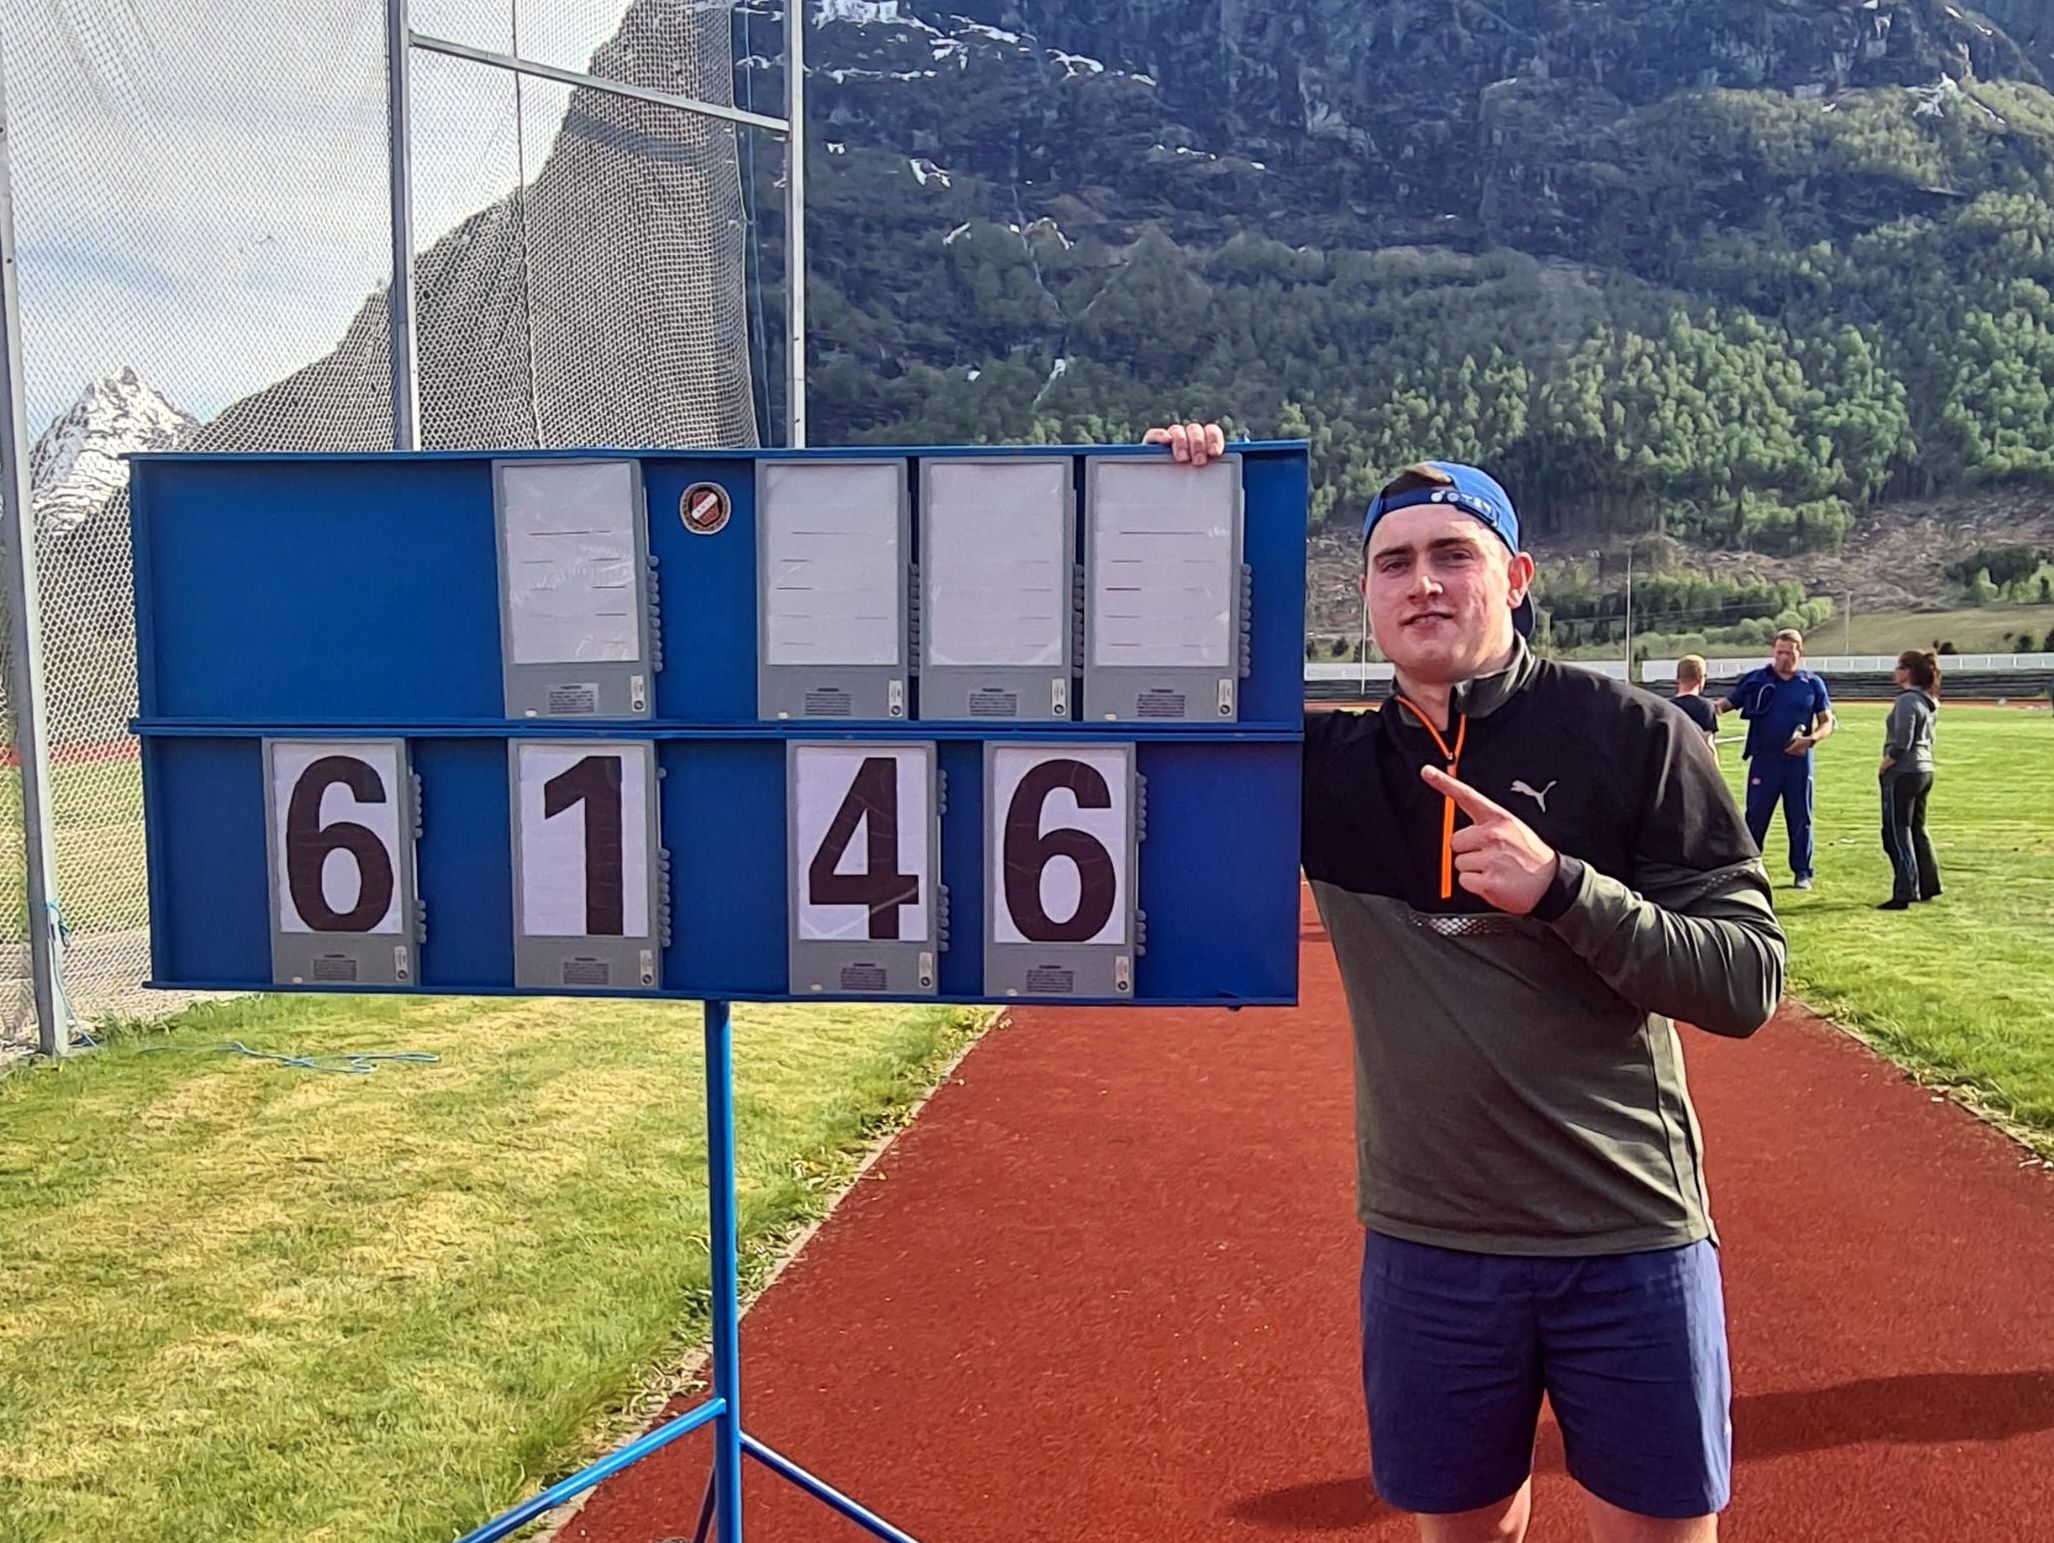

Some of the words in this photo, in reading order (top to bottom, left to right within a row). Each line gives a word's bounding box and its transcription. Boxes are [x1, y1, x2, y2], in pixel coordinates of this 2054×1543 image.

[286, 755, 394, 932] 6
[544, 756, 624, 935] 1
[809, 757, 919, 939] 4
[1003, 758, 1117, 942] 6
